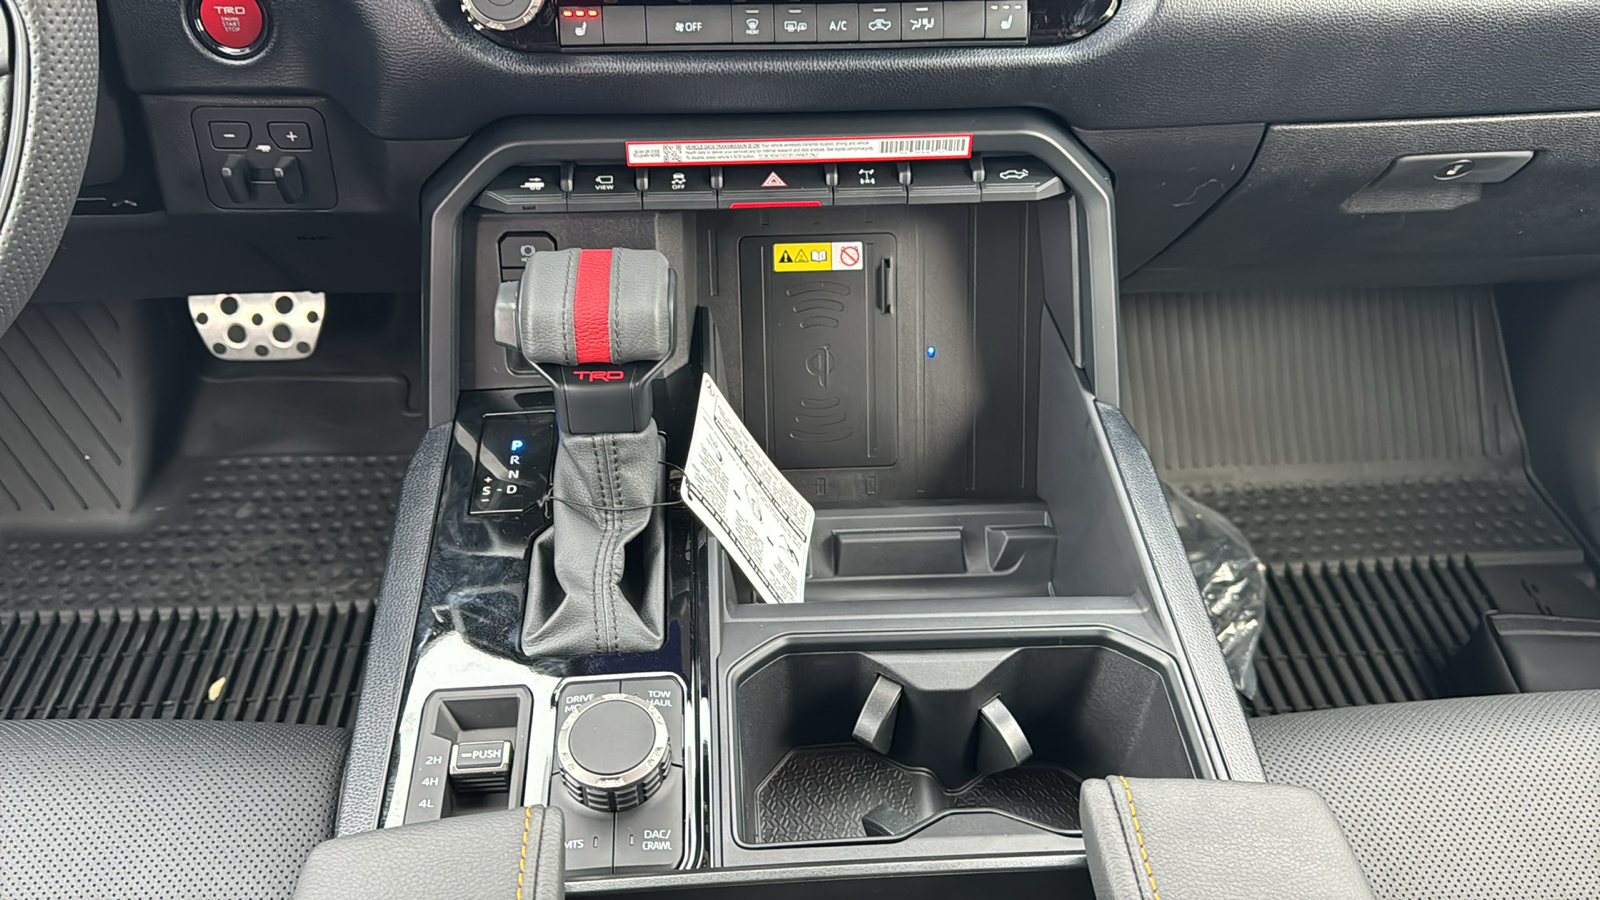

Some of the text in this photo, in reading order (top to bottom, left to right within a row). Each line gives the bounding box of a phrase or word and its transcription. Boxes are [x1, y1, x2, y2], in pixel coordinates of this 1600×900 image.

[213, 6, 246, 14] TRD
[685, 22, 702, 31] OFF
[829, 20, 847, 31] A/C
[573, 371, 624, 382] TRD
[511, 440, 523, 451] P
[510, 455, 520, 465] R
[508, 470, 519, 479] N
[506, 485, 517, 494] D
[648, 690, 671, 698] TOW
[566, 694, 595, 704] DRIVE
[472, 750, 500, 759] PUSH
[425, 756, 442, 765] 2H
[421, 777, 438, 786] 4H
[419, 800, 434, 808] 4L
[644, 830, 672, 839] DAC/
[642, 841, 673, 850] CRAWL
